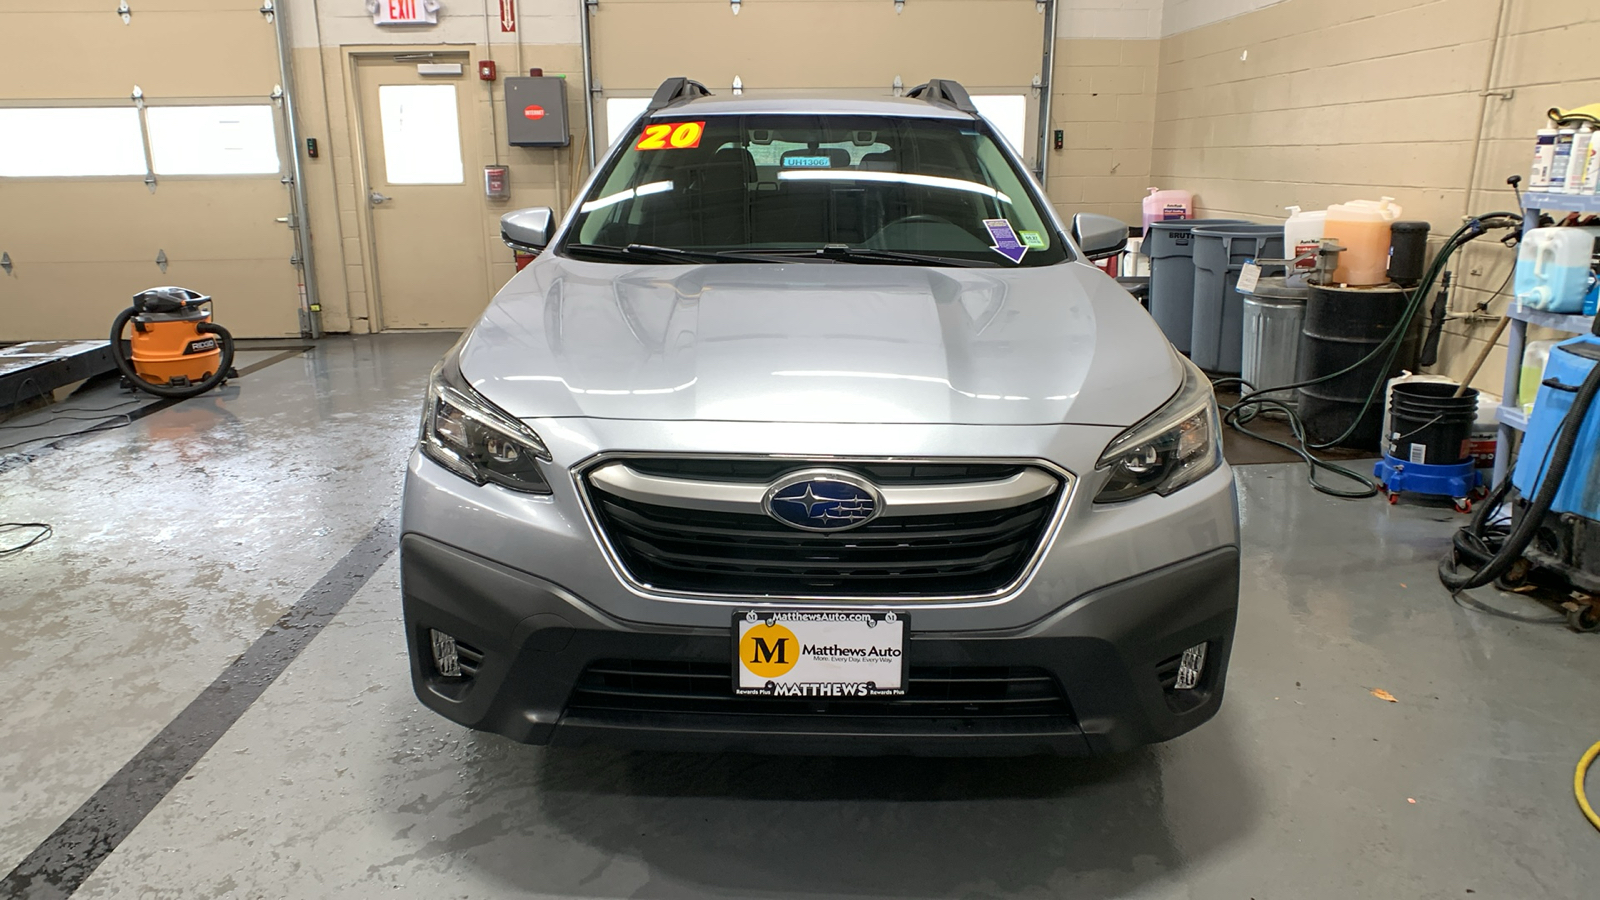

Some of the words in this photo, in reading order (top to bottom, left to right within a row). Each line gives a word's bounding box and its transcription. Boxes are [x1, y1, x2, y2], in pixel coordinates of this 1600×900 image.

[388, 0, 416, 20] EXIT
[637, 122, 702, 149] 20
[772, 611, 871, 622] MatthewsAuto.com
[750, 637, 789, 664] M
[802, 644, 867, 656] Matthews
[867, 645, 902, 657] Auto
[774, 682, 868, 696] MATTHEWS
